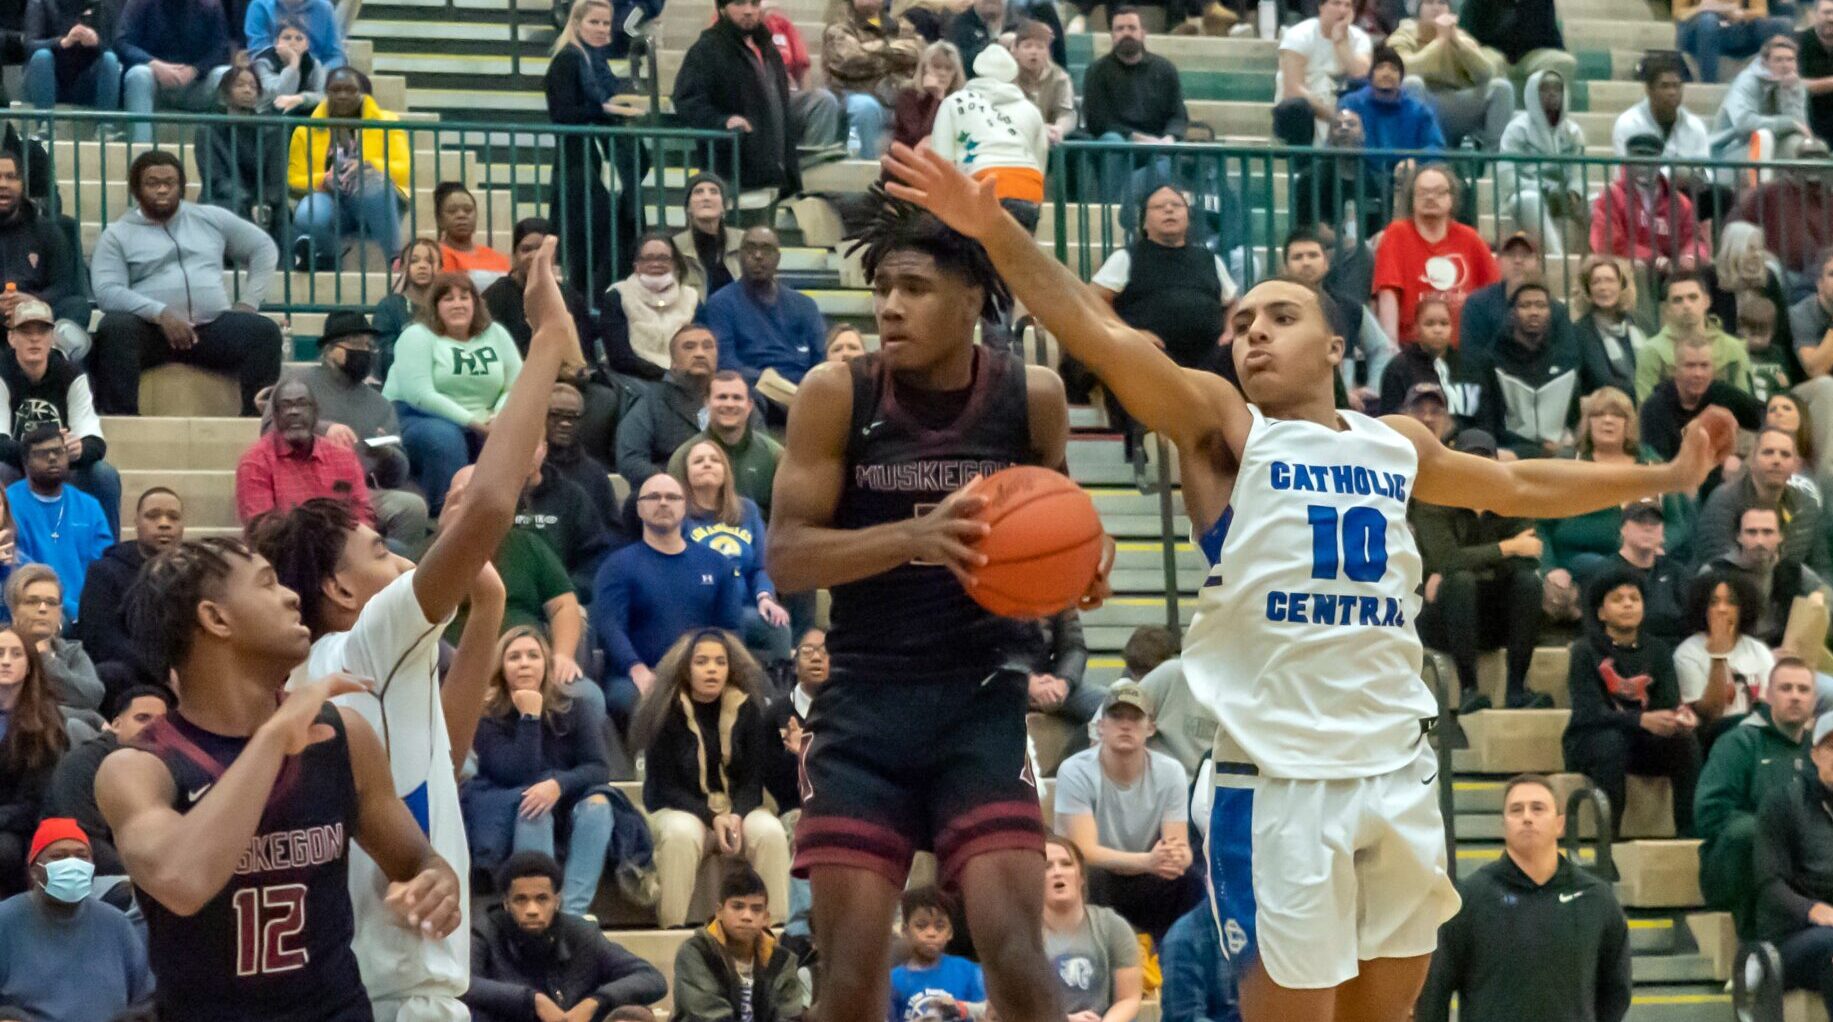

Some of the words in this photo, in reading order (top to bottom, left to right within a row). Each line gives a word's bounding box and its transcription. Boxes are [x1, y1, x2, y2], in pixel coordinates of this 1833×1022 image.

[855, 459, 1018, 492] MUSKEGO
[1270, 460, 1407, 503] CATHOLIC
[1307, 504, 1388, 583] 10
[234, 822, 344, 875] SKEGON
[232, 883, 310, 976] 12
